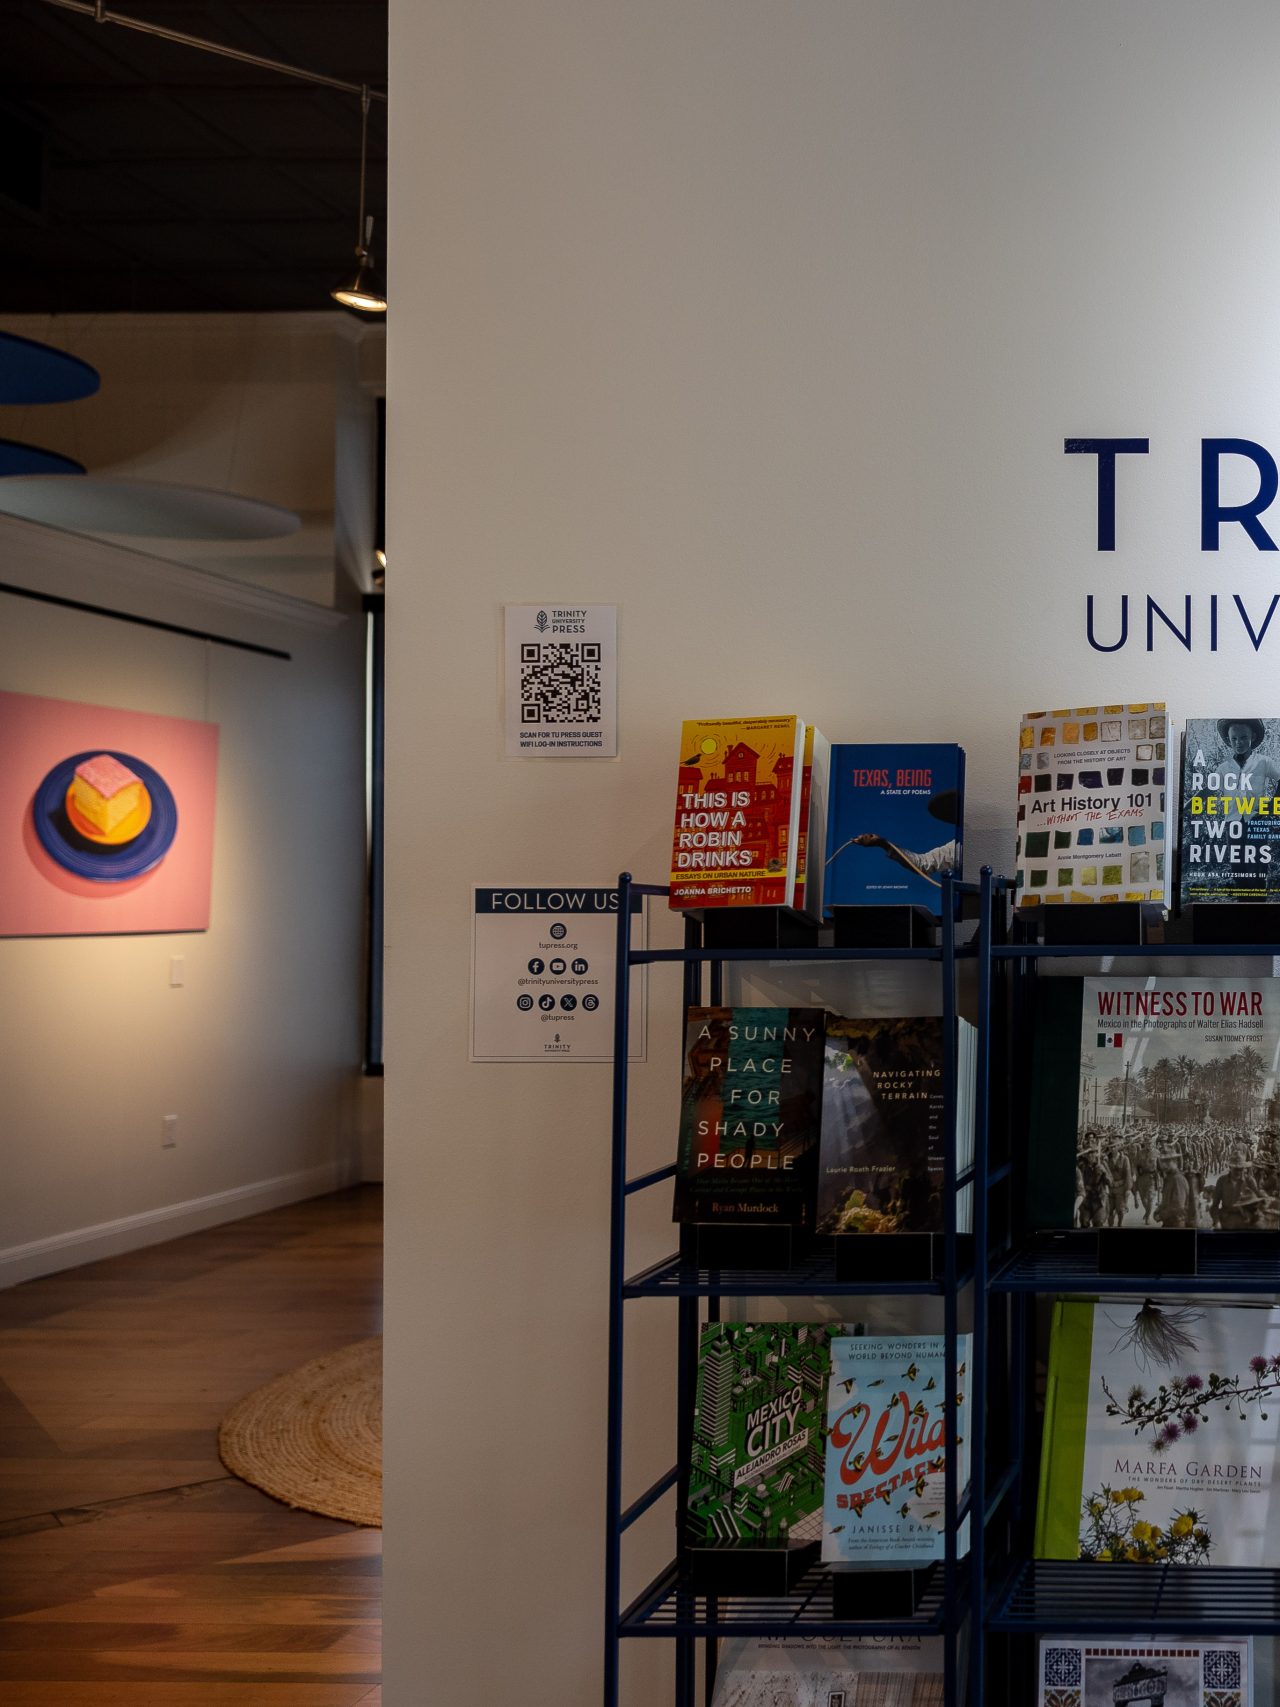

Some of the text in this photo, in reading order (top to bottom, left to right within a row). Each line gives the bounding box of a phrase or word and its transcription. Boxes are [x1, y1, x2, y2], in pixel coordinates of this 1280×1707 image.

[552, 610, 587, 618] TRINITY
[552, 625, 586, 633] PRESS
[1193, 750, 1206, 767] A
[853, 769, 932, 789] TEXAS, BEING
[1192, 772, 1253, 791] ROCK
[682, 791, 751, 809] THIS IS
[1031, 793, 1152, 814] Art History 101
[680, 811, 747, 829] HOW A
[1084, 811, 1103, 821] THE
[1106, 808, 1145, 820] EXAMS
[1190, 820, 1243, 839] TWO
[679, 831, 742, 848] ROBIN
[677, 850, 753, 868] DRINKS
[1189, 844, 1272, 864] RIVERS
[676, 869, 767, 880] ESSAYS ON URBAN NATURE
[674, 886, 752, 896] JOANNA BRICHETTO
[492, 893, 619, 910] FOLLOW US
[539, 942, 578, 950] tupress.org
[518, 978, 599, 986] @trinityuniversitypress
[1097, 991, 1263, 1016] WITNESS TO WAR
[540, 1014, 575, 1022] @tupress
[1097, 1019, 1264, 1030] Mexico in the Photographs of Walter Elias Hadsell
[698, 1025, 816, 1042] A SUNNY
[1246, 1034, 1263, 1042] FROST
[710, 1057, 793, 1073] PLACE
[873, 1069, 941, 1078] NAVIGATING
[877, 1081, 913, 1089] ROCKY
[730, 1089, 781, 1105] FOR
[881, 1092, 928, 1100] TERRAIN
[698, 1120, 785, 1137] SHADY
[697, 1153, 795, 1170] PEOPLE
[712, 1202, 779, 1215] Ryan Murdock
[850, 1343, 883, 1351] SEEKING
[887, 1342, 926, 1350] WONDERS
[747, 1385, 802, 1430] MEXICO
[747, 1403, 801, 1457] CITY
[736, 1431, 807, 1480] ALEJANDRO ROSAS
[1114, 1459, 1262, 1479] MARFA GARDEN
[852, 1524, 932, 1534] JANISSE RAY
